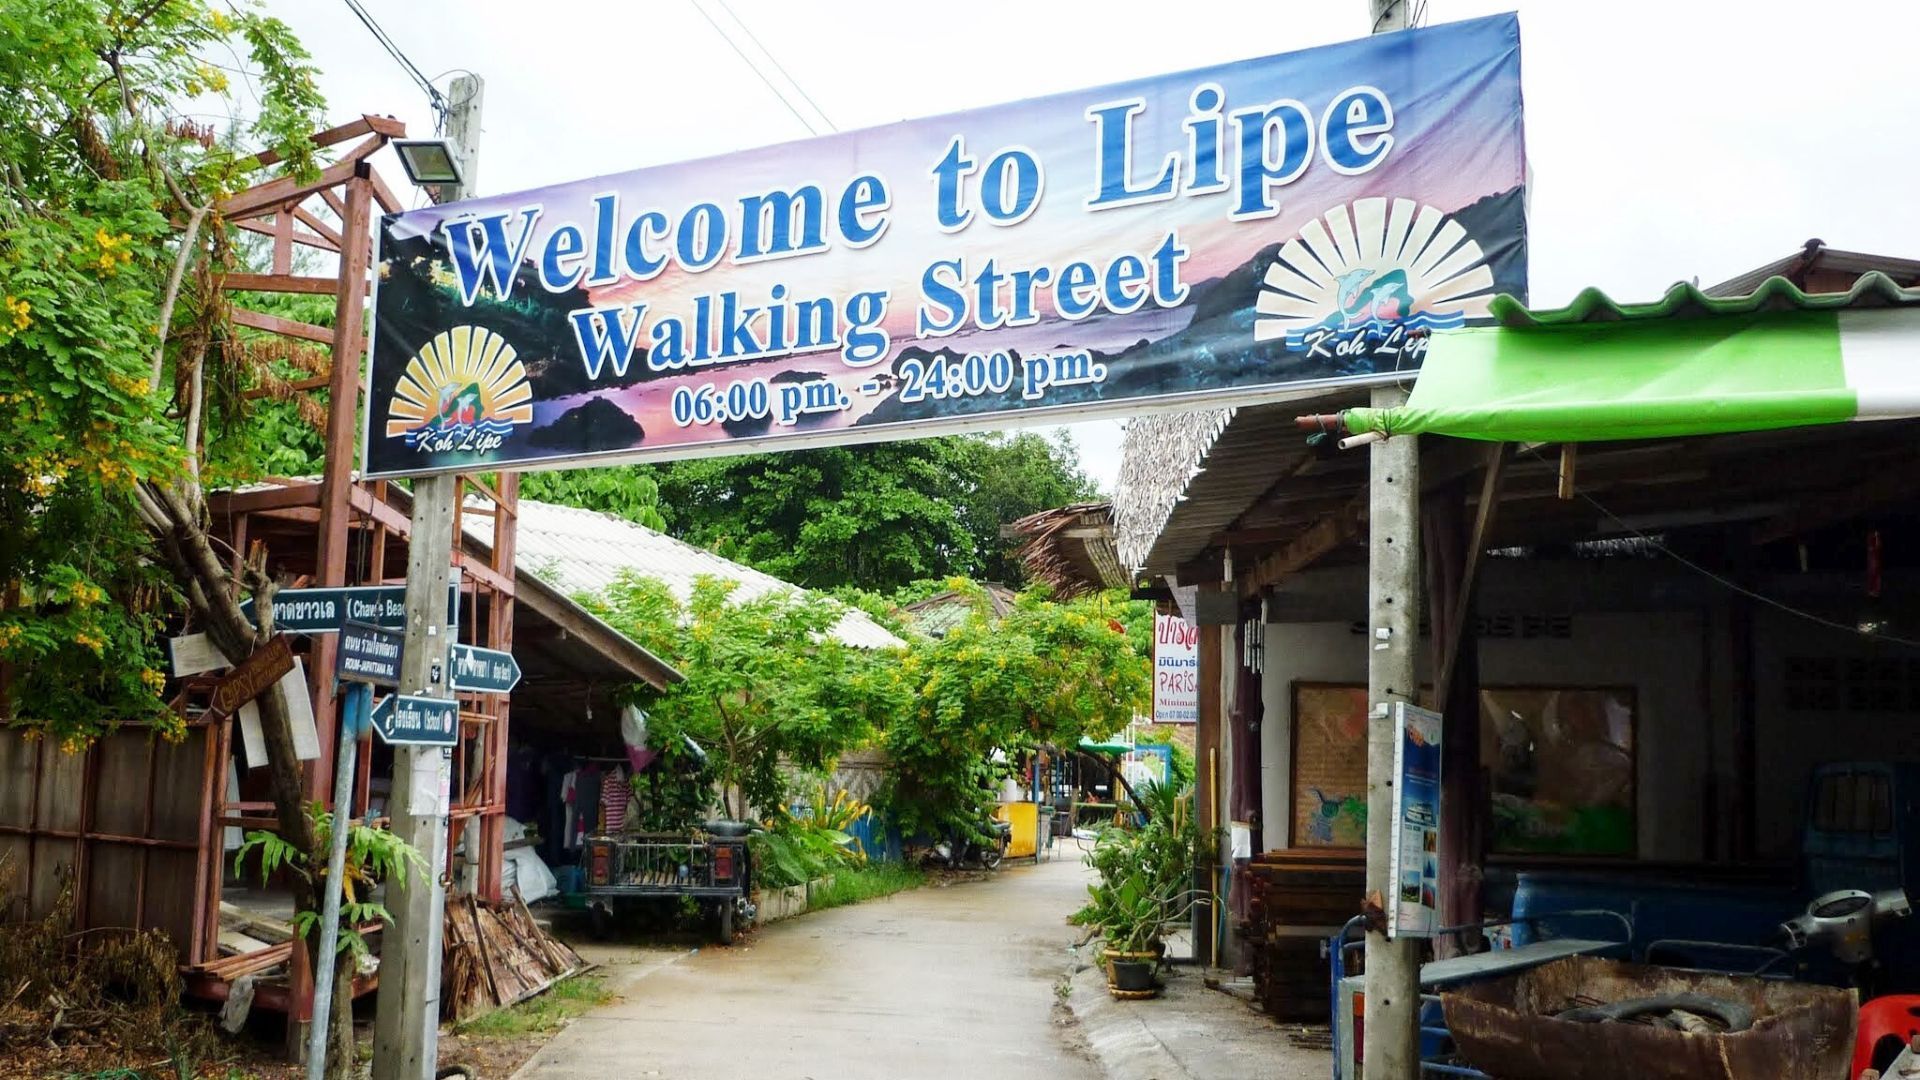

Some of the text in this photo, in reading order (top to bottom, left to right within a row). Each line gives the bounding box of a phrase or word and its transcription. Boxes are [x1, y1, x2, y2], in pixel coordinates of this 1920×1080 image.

[442, 83, 1394, 305] Welcome to Lipe
[570, 231, 1189, 379] Walking Street
[1303, 325, 1429, 359] Koh Lip
[673, 377, 769, 427] 06:00
[780, 379, 852, 425] pm.
[901, 349, 1013, 402] 24:00
[1021, 350, 1107, 399] pm.
[416, 428, 502, 455] Koh Lipe
